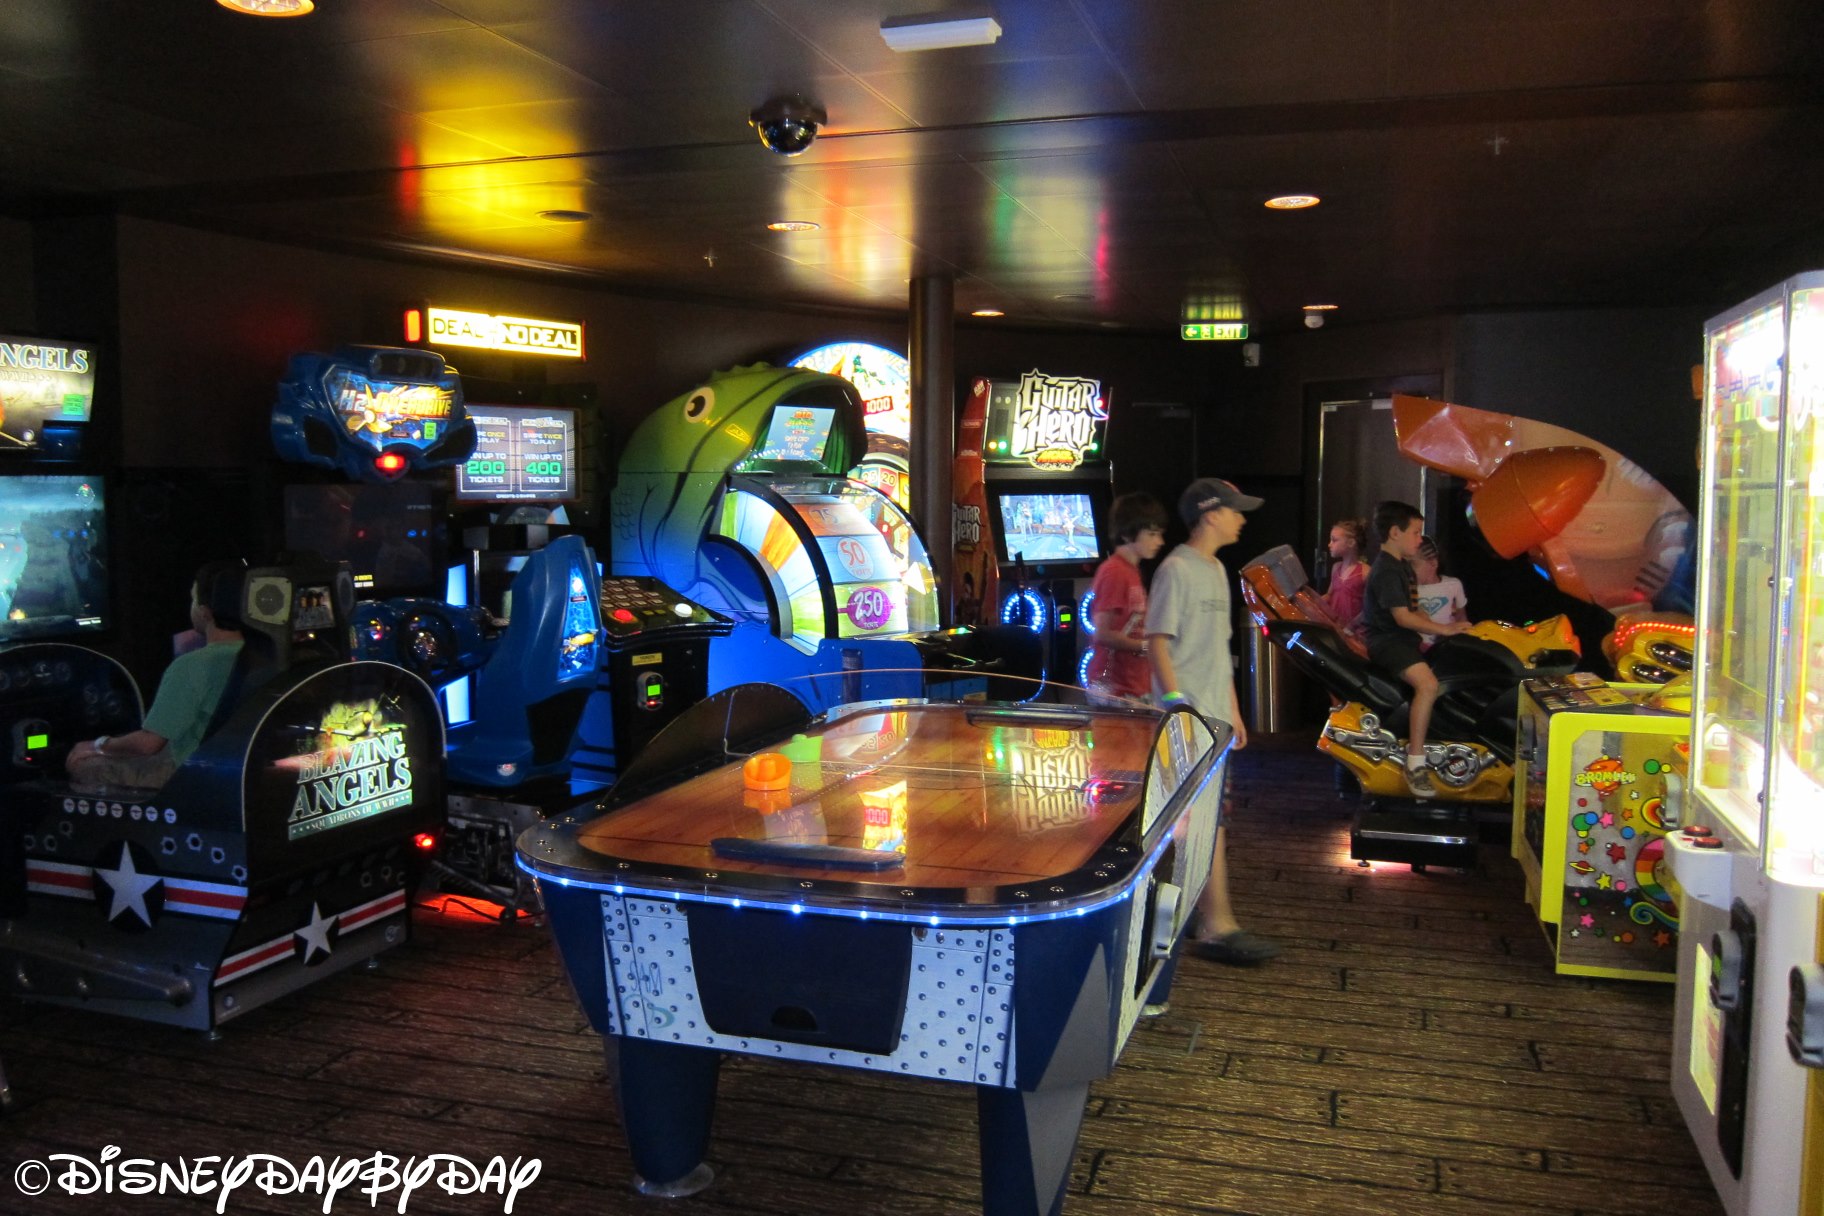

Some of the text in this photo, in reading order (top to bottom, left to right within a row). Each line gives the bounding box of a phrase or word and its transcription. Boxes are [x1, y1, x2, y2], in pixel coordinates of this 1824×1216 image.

[433, 317, 485, 339] DEAL
[502, 324, 528, 344] NO
[530, 327, 577, 349] DEAL
[1214, 324, 1242, 338] EXIT
[866, 397, 890, 413] 1000
[1020, 373, 1100, 416] GUITAR
[1022, 406, 1091, 453] HERO
[467, 460, 505, 476] 200
[525, 461, 562, 476] 400
[882, 474, 897, 487] 20
[839, 540, 866, 566] 50
[853, 590, 884, 621] 250
[296, 731, 406, 784] BLAZING
[287, 757, 414, 823] ANGELS
